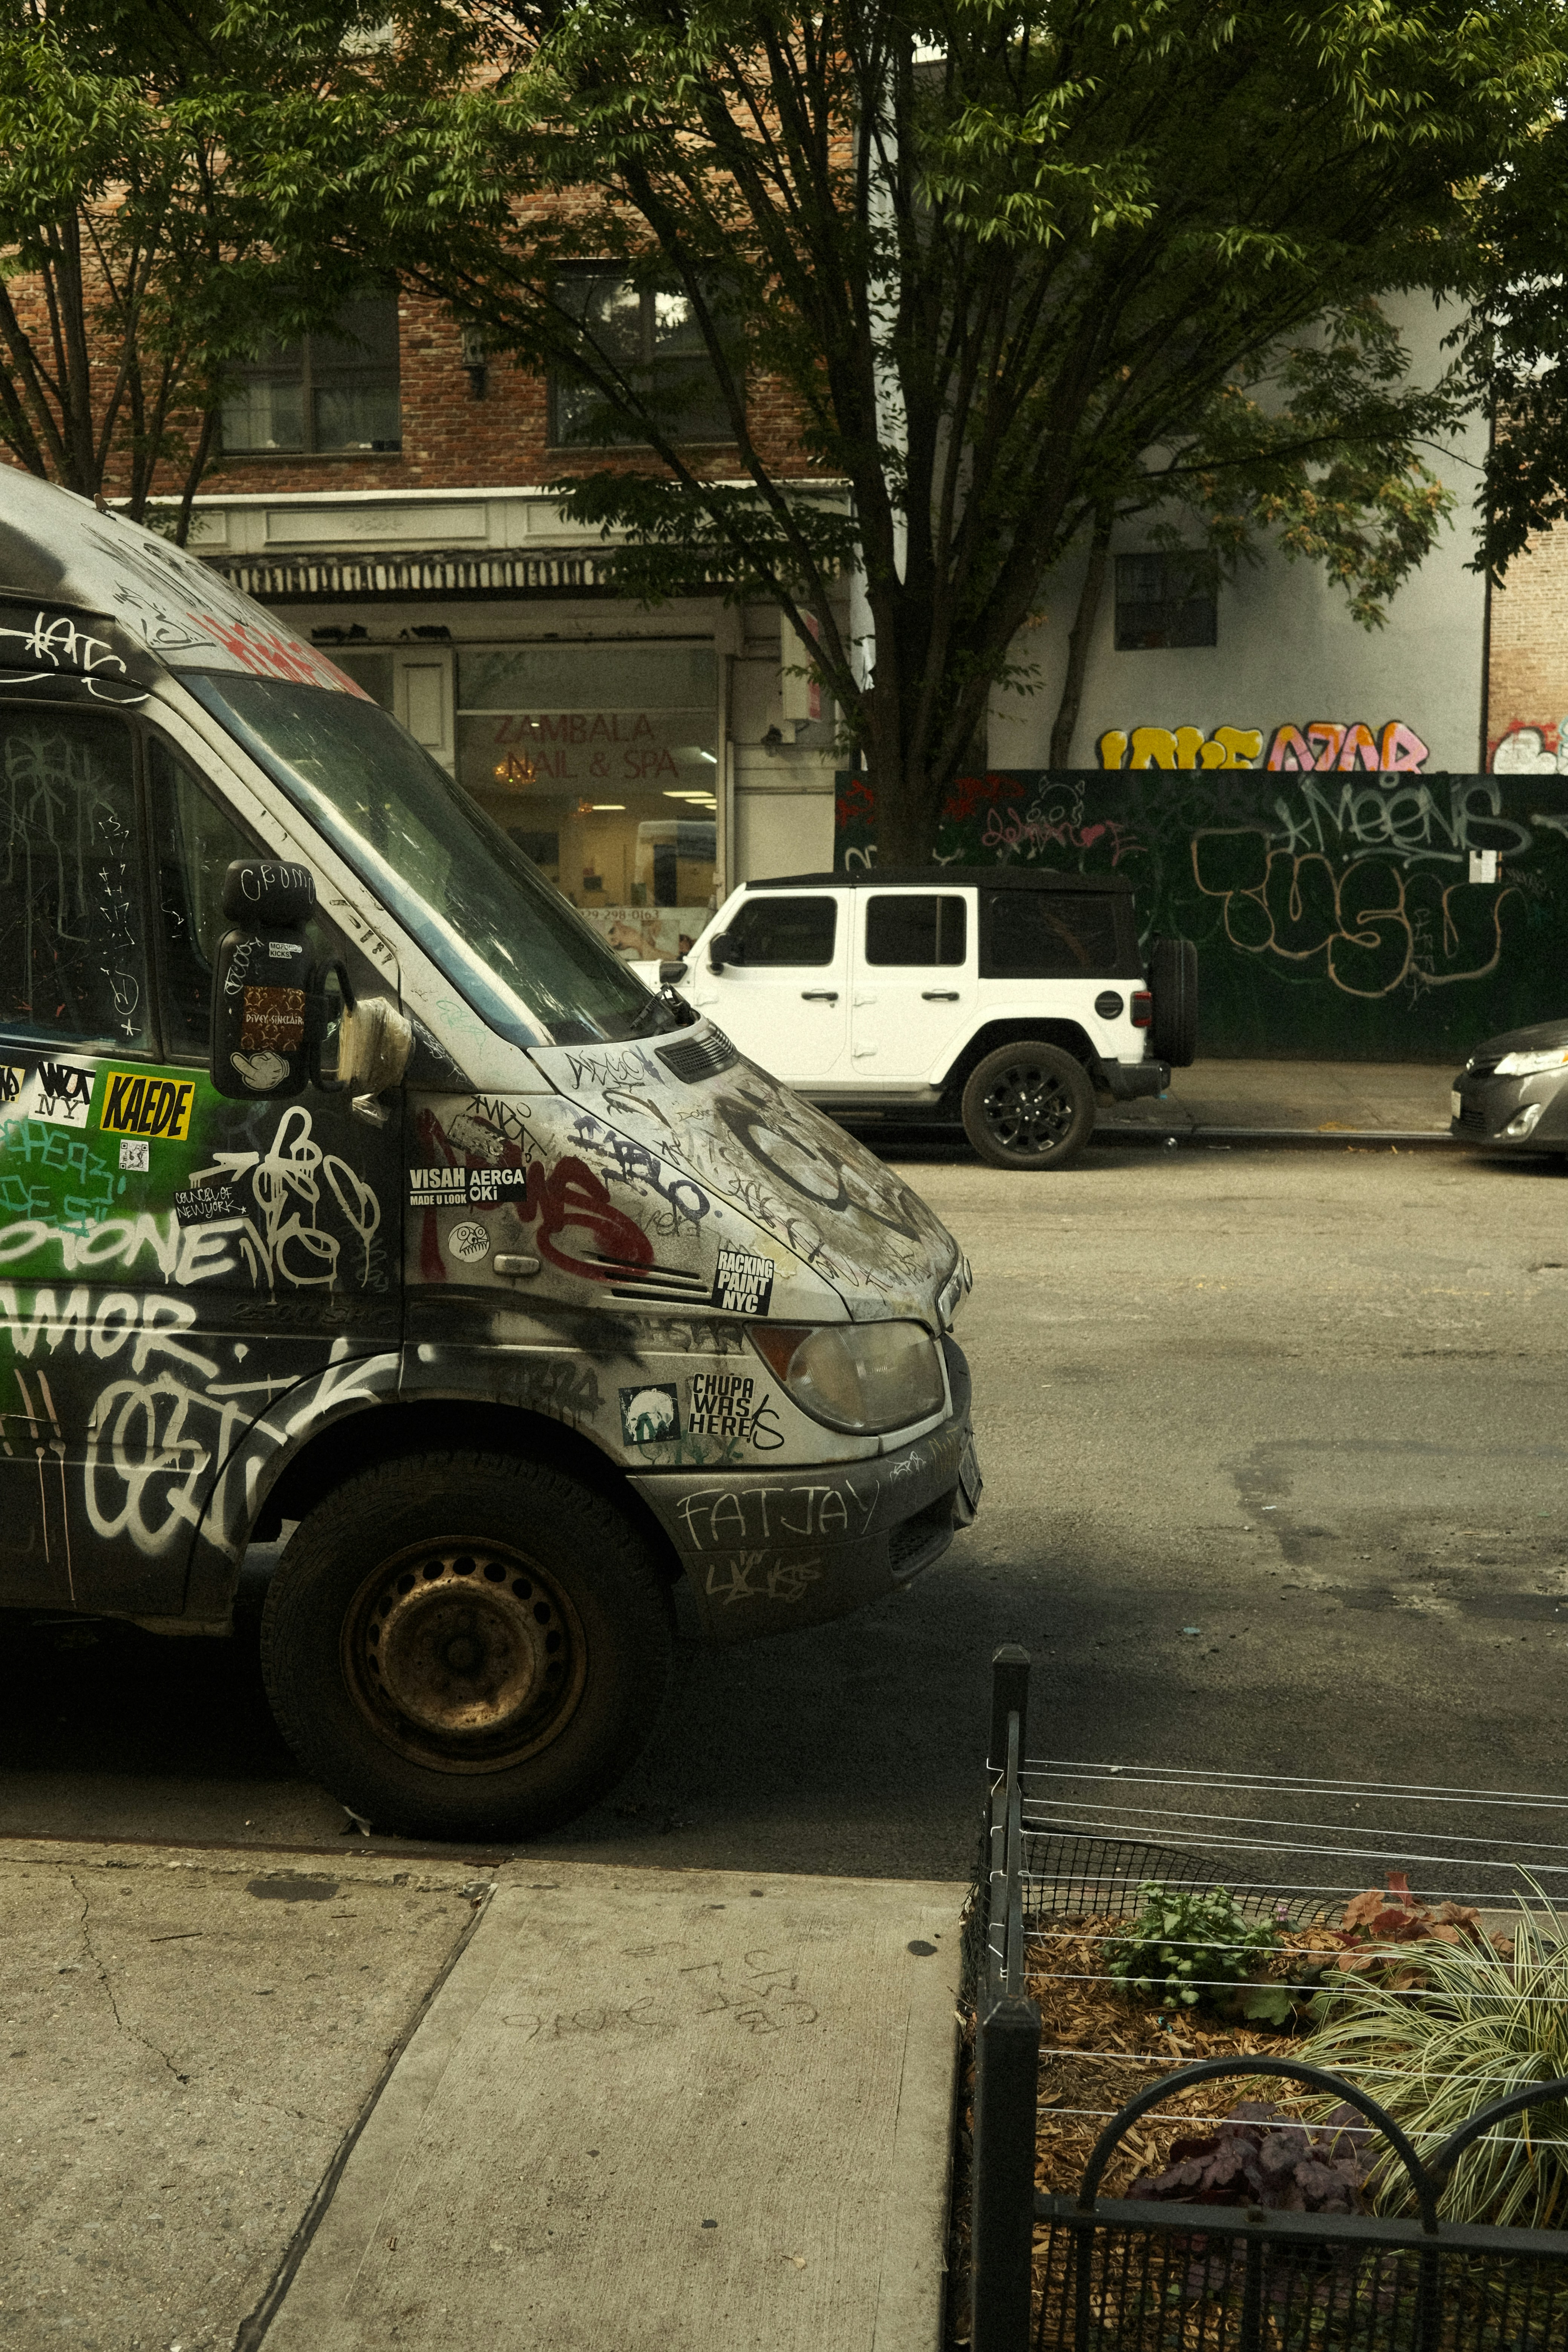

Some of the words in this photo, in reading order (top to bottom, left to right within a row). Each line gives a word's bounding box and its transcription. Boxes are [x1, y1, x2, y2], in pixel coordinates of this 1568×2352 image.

[495, 715, 655, 744] ZAMBALA
[507, 751, 577, 779] NAIL
[589, 753, 610, 777] &
[624, 750, 678, 779] SPA
[270, 943, 301, 951] MOFONGO
[34, 1093, 84, 1119] NY
[102, 1075, 193, 1137] KAEDE
[410, 1168, 465, 1189] VISAH
[470, 1169, 524, 1185] AERGA
[410, 1195, 435, 1206] MADE
[436, 1195, 443, 1205] U
[444, 1194, 467, 1205] LOOK
[718, 1251, 773, 1279] RACKING
[717, 1270, 769, 1296] PAINT
[722, 1290, 758, 1313] NYC
[693, 1374, 754, 1398] CHUPA
[694, 1393, 750, 1417] WAS
[689, 1413, 751, 1437] HERE
